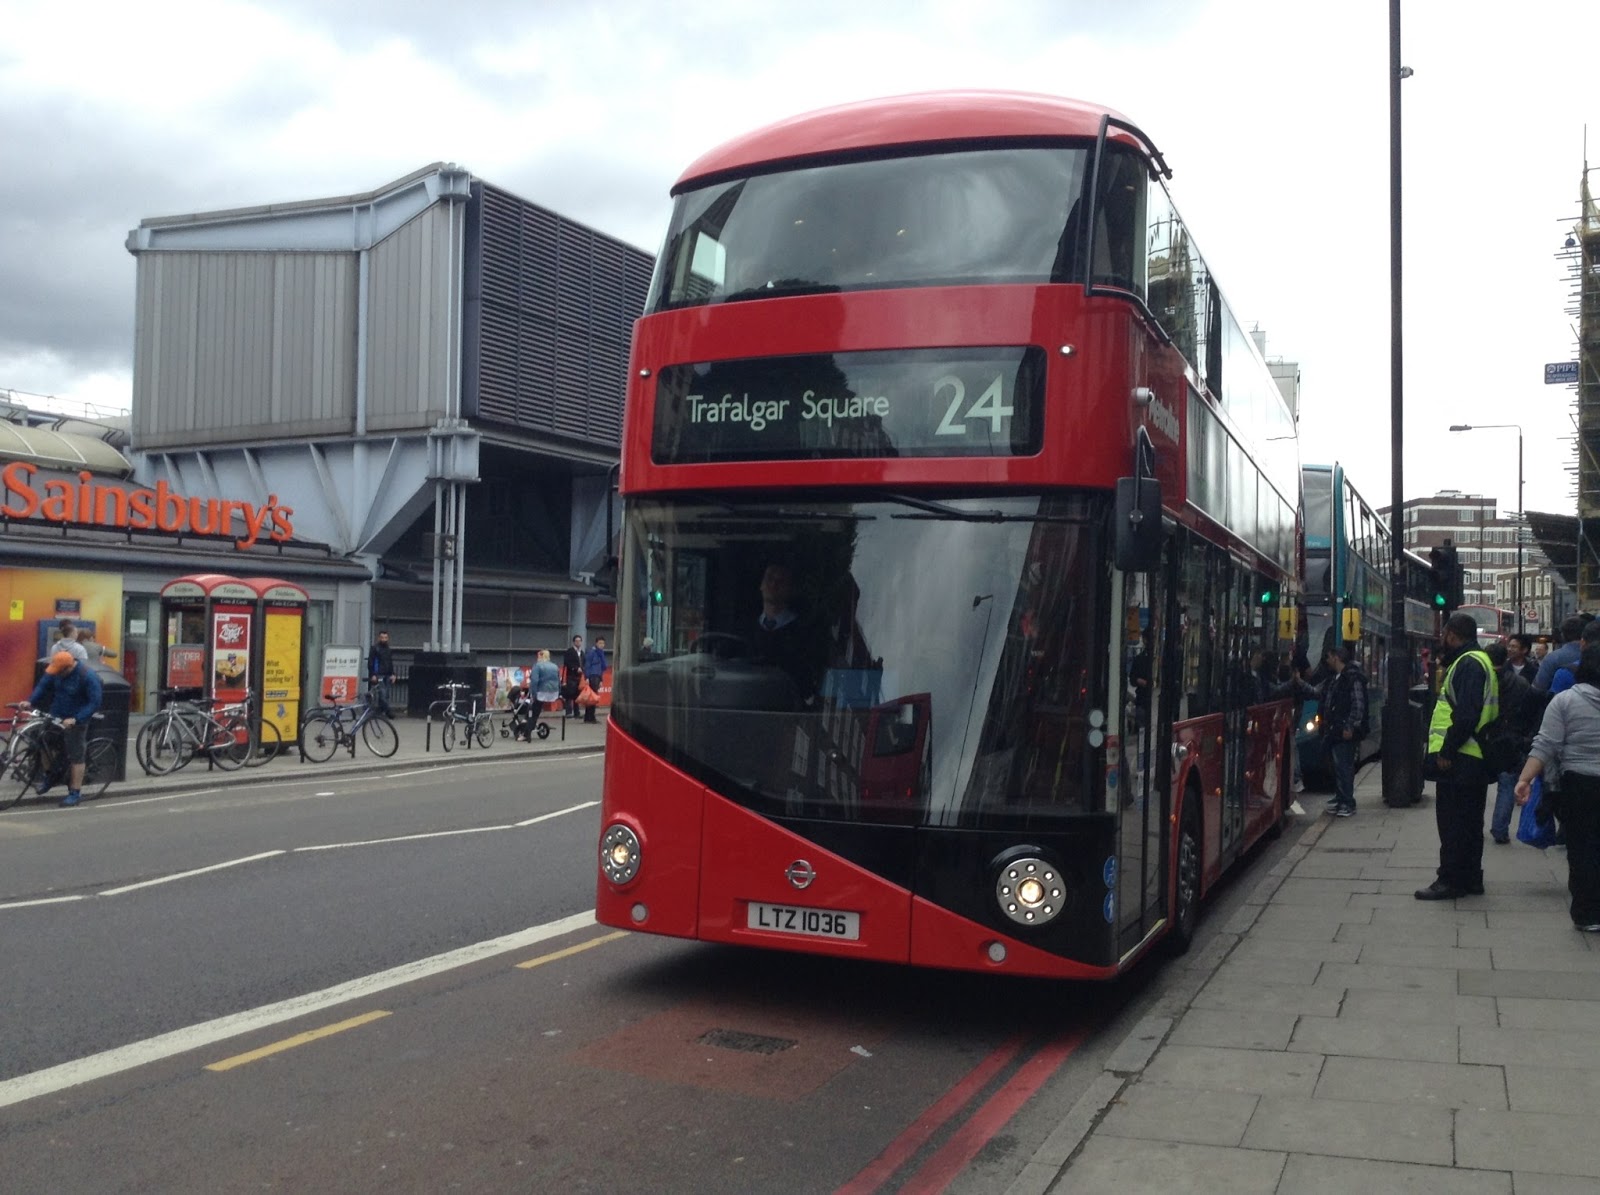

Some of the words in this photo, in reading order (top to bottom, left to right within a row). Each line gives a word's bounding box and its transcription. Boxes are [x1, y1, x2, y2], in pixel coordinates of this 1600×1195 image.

[686, 393, 790, 431] Trafalgar
[801, 390, 890, 427] Square
[933, 373, 1014, 436] 24
[1, 461, 294, 549] Sainsbury's
[223, 587, 246, 595] Telephone
[759, 907, 797, 930] LTZ
[802, 911, 846, 935] 1036
